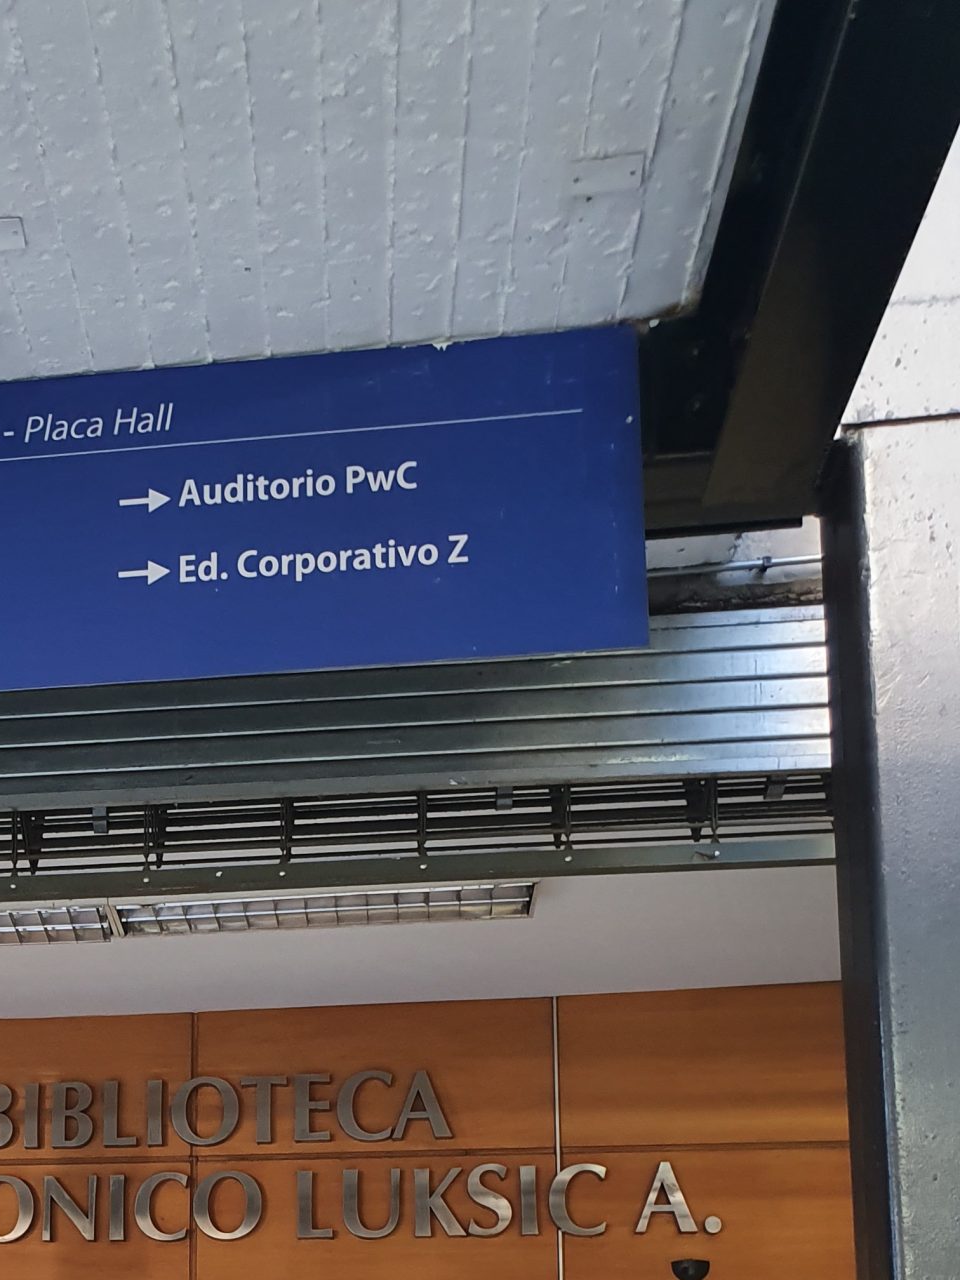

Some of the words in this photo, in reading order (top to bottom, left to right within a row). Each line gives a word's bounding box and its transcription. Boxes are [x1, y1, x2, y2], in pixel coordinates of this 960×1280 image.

[24, 413, 103, 443] Placa
[113, 402, 174, 435] Hall
[178, 468, 336, 507] Auditorio
[346, 460, 418, 494] PwC
[179, 551, 229, 583] Ed.
[237, 539, 439, 582] Corporativo
[447, 534, 469, 564] Z
[295, 1163, 608, 1240] LUKSIC
[635, 1161, 723, 1235] A.
